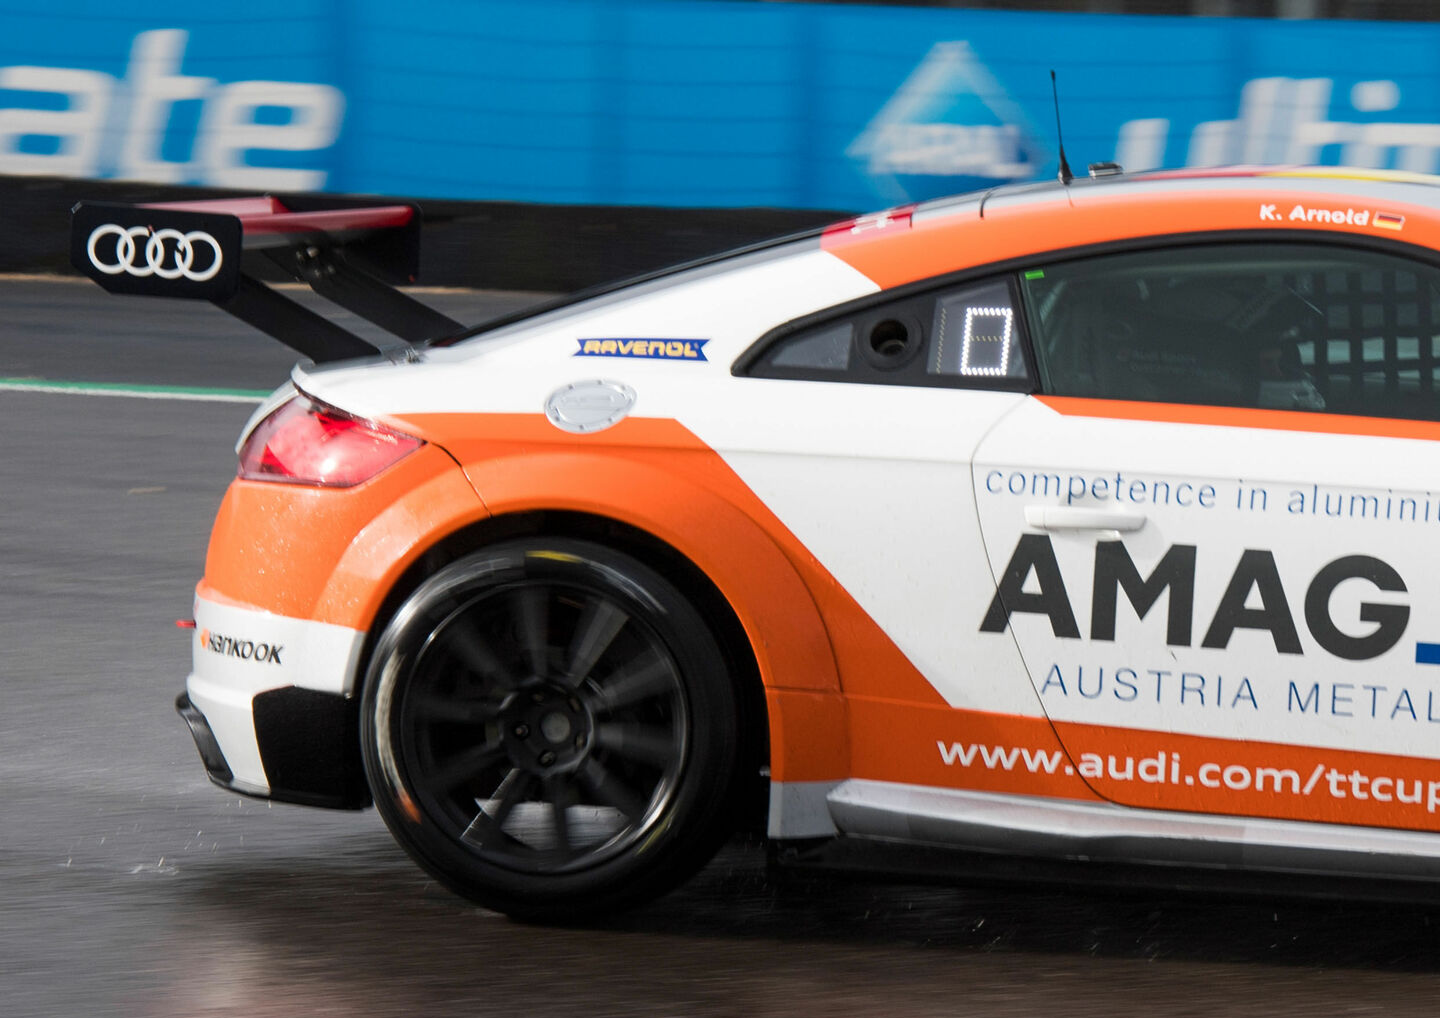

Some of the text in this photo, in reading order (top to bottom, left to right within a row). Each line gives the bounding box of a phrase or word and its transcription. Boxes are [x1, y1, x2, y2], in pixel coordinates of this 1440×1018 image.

[1259, 204, 1370, 226] K. Arnold
[584, 339, 699, 358] RAVENOL
[986, 469, 1216, 508] competence
[1237, 479, 1267, 512] in
[1041, 663, 1259, 712] AUSTRIA
